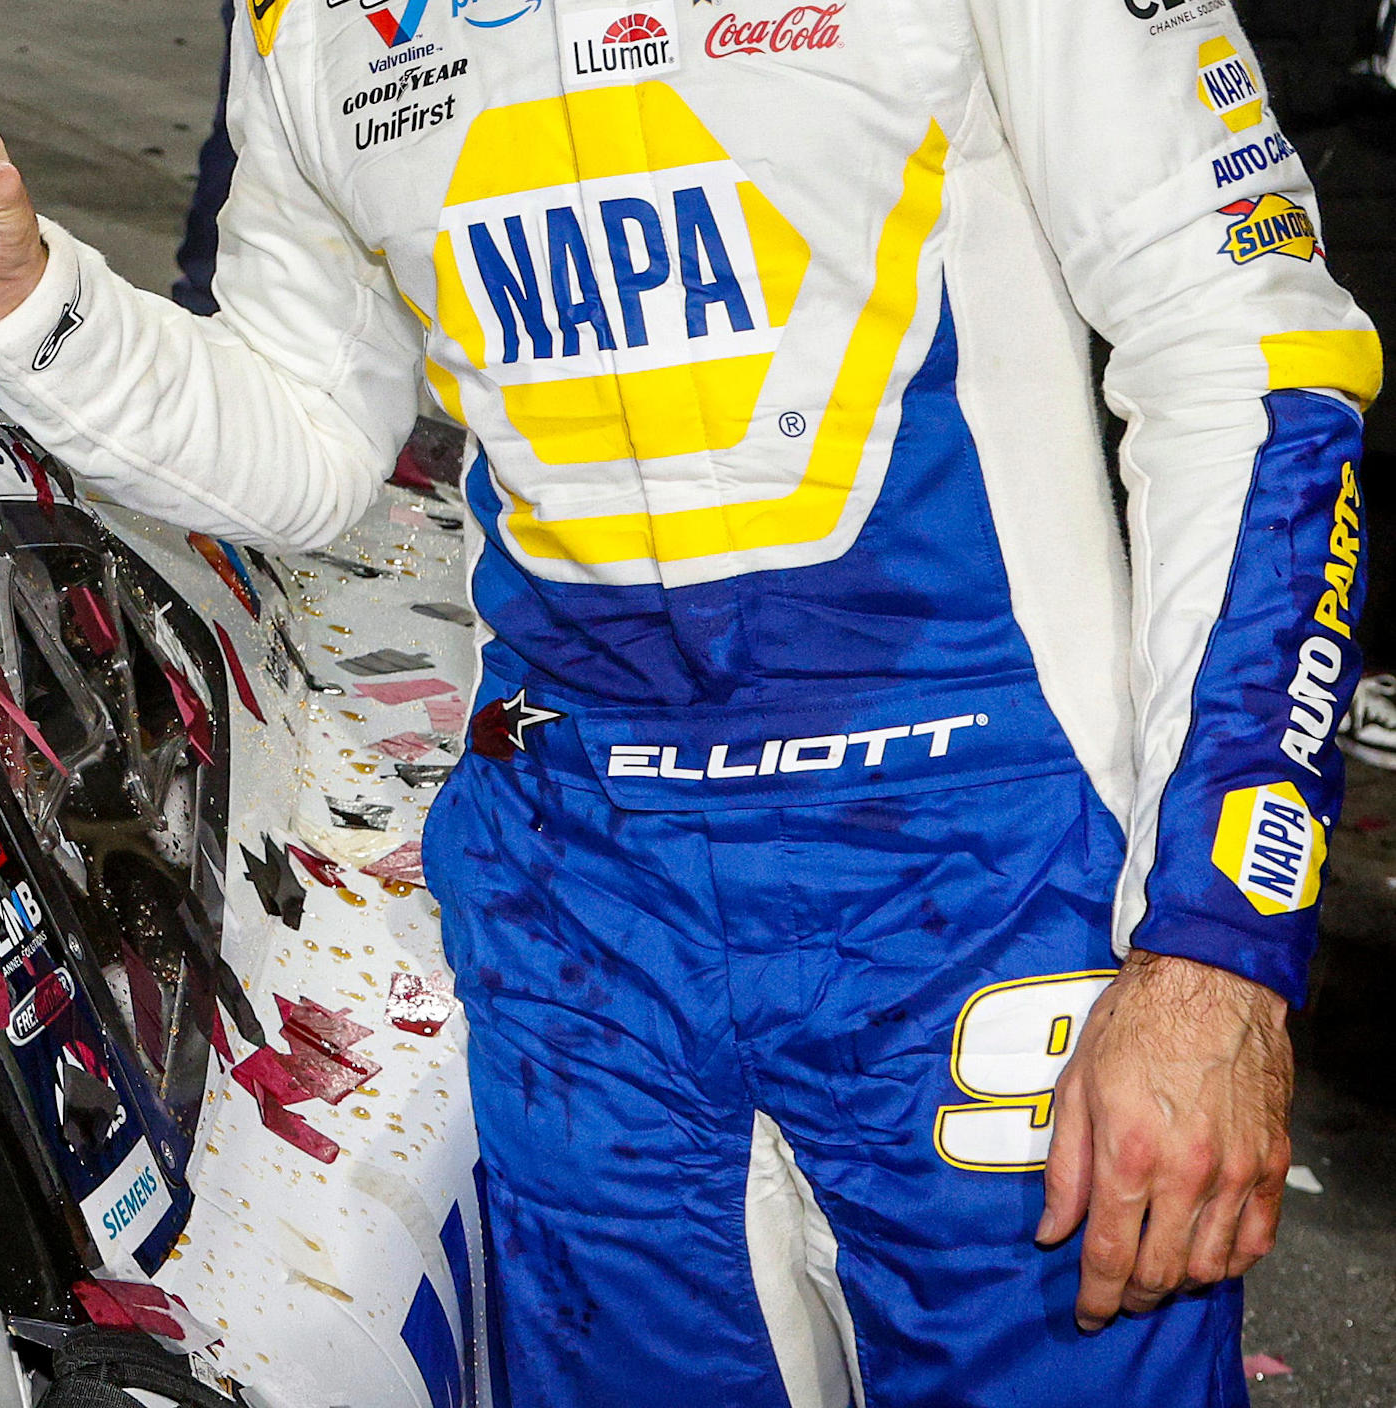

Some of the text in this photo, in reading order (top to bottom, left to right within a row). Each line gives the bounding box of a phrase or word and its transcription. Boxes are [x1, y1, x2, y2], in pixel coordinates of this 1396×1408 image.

[704, 3, 846, 58] Coca-Cola
[1149, 10, 1197, 36] CHANNEL
[369, 43, 435, 74] Valvoline
[574, 38, 670, 75] LLumar
[1204, 60, 1257, 108] NAPA
[342, 58, 469, 115] GOODYEAR
[355, 95, 456, 150] UniFirst
[1212, 144, 1268, 188] AUTO
[468, 186, 755, 364] NAPA
[1248, 461, 1360, 899] NAPA AUTO PARTS
[609, 714, 975, 780] ELLIOTT
[103, 1166, 157, 1241] SIEMENS
